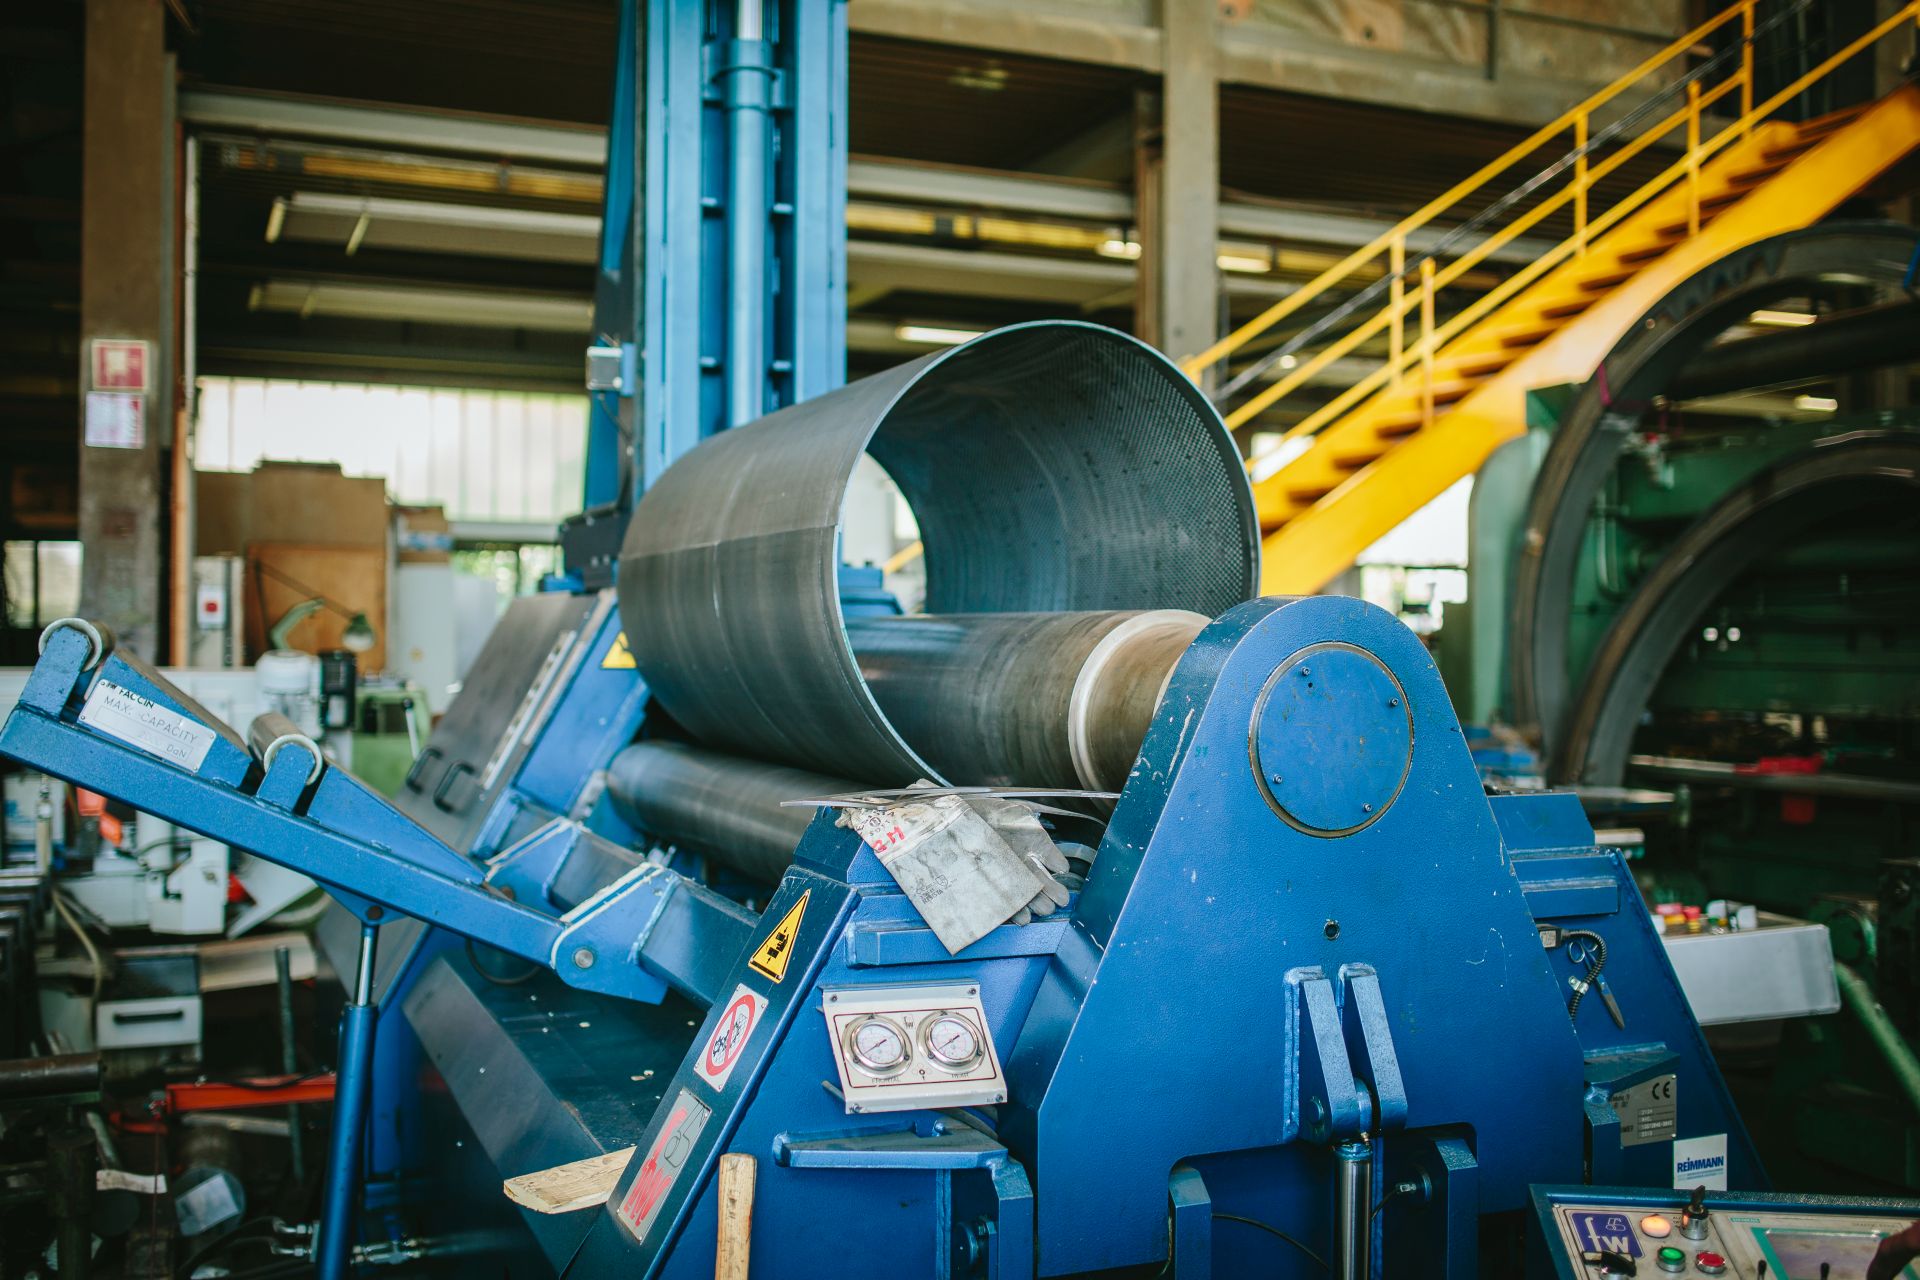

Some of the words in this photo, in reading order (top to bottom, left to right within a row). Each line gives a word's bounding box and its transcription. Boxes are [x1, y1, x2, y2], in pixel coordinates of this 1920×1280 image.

[119, 689, 154, 709] FACCIN
[104, 696, 131, 716] MAX.
[140, 713, 198, 743] CAPACITY
[1652, 1081, 1671, 1100] CE
[1584, 1216, 1629, 1254] fw
